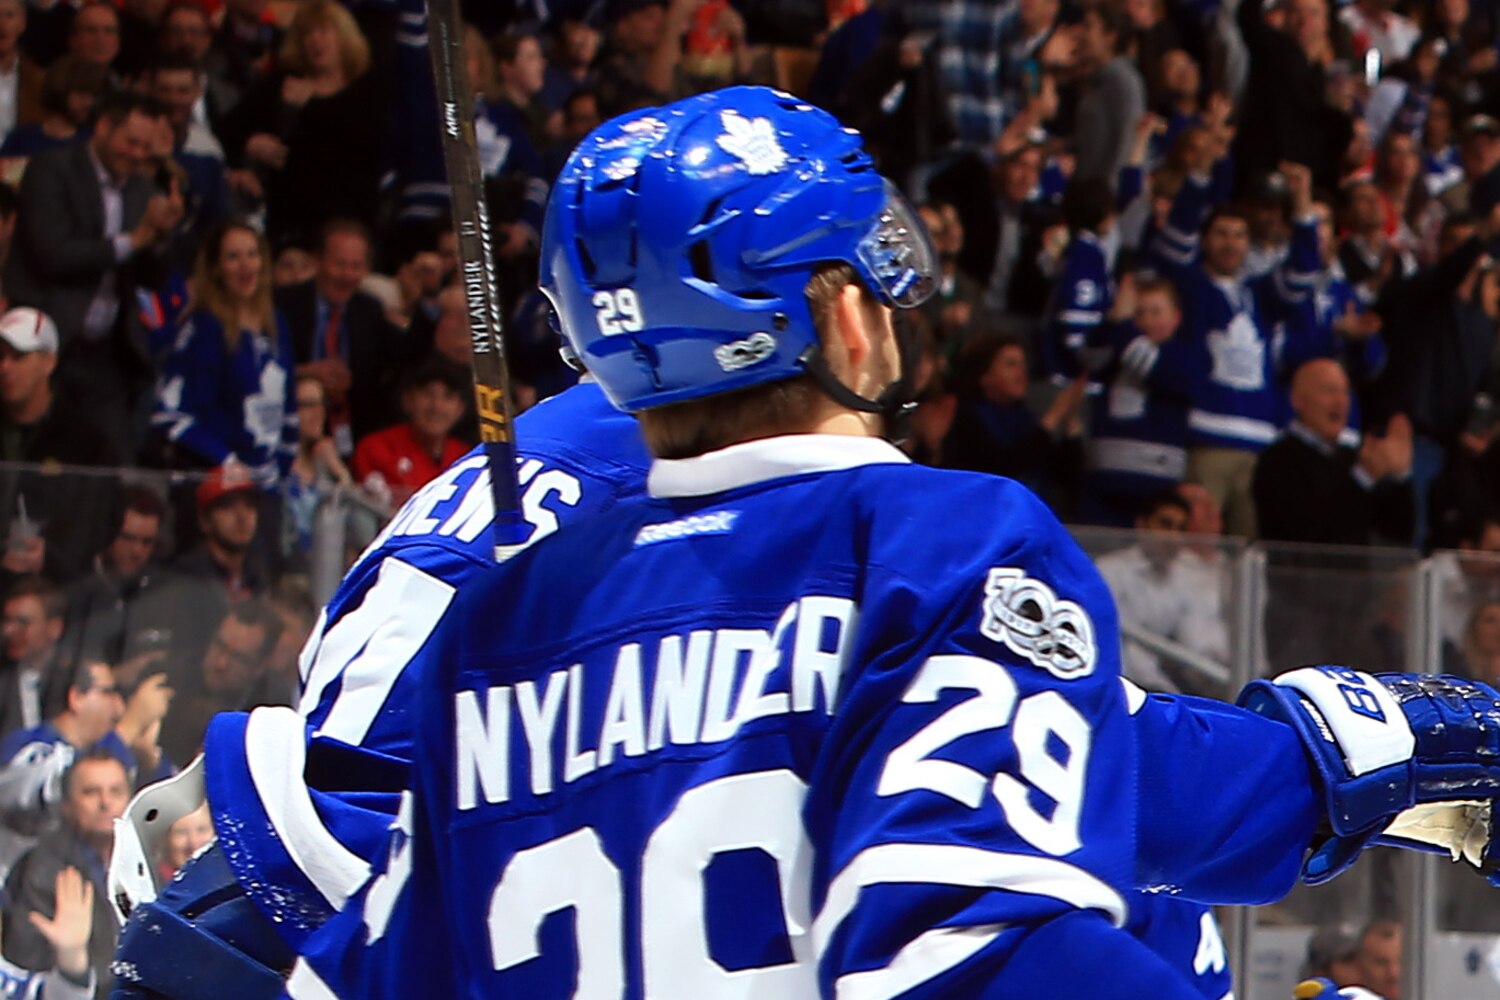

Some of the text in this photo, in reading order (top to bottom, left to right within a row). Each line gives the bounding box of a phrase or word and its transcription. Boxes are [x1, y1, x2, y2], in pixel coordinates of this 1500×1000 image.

[464, 259, 491, 354] NYLANDER
[592, 287, 643, 336] 29
[455, 595, 859, 811] NYLANDER
[875, 654, 1092, 857] 29
